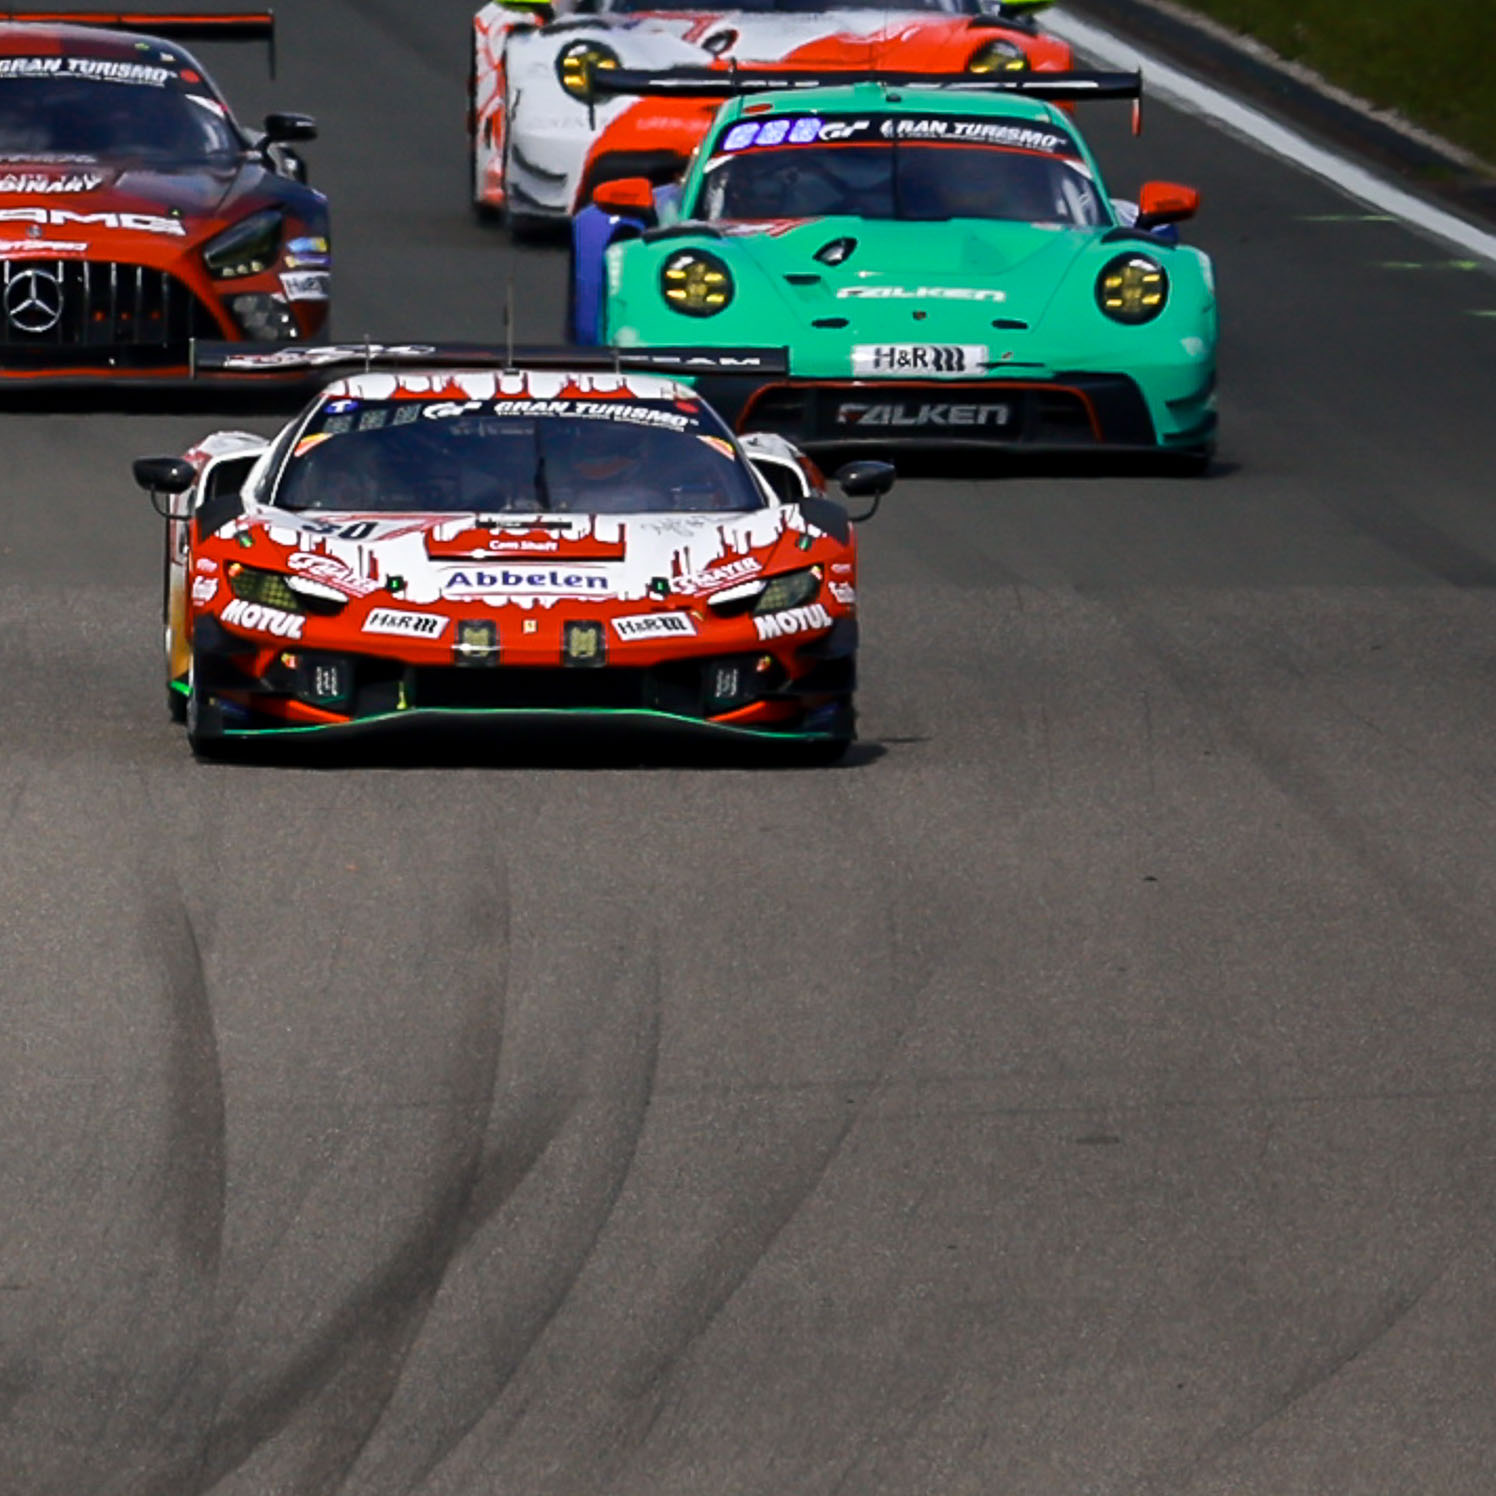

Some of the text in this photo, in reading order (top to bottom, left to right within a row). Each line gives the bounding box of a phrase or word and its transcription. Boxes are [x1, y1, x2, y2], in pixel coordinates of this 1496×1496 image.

[67, 58, 173, 81] TURISMO
[953, 121, 1059, 147] TURISMO
[836, 285, 1008, 303] FALKEN
[873, 346, 929, 369] H&R
[493, 402, 570, 415] GRAN
[574, 403, 691, 426] TURISMO
[836, 403, 1010, 425] FALKEN
[446, 569, 609, 590] Abbelen
[220, 598, 307, 640] MOTUL
[752, 603, 834, 641] MOTUL
